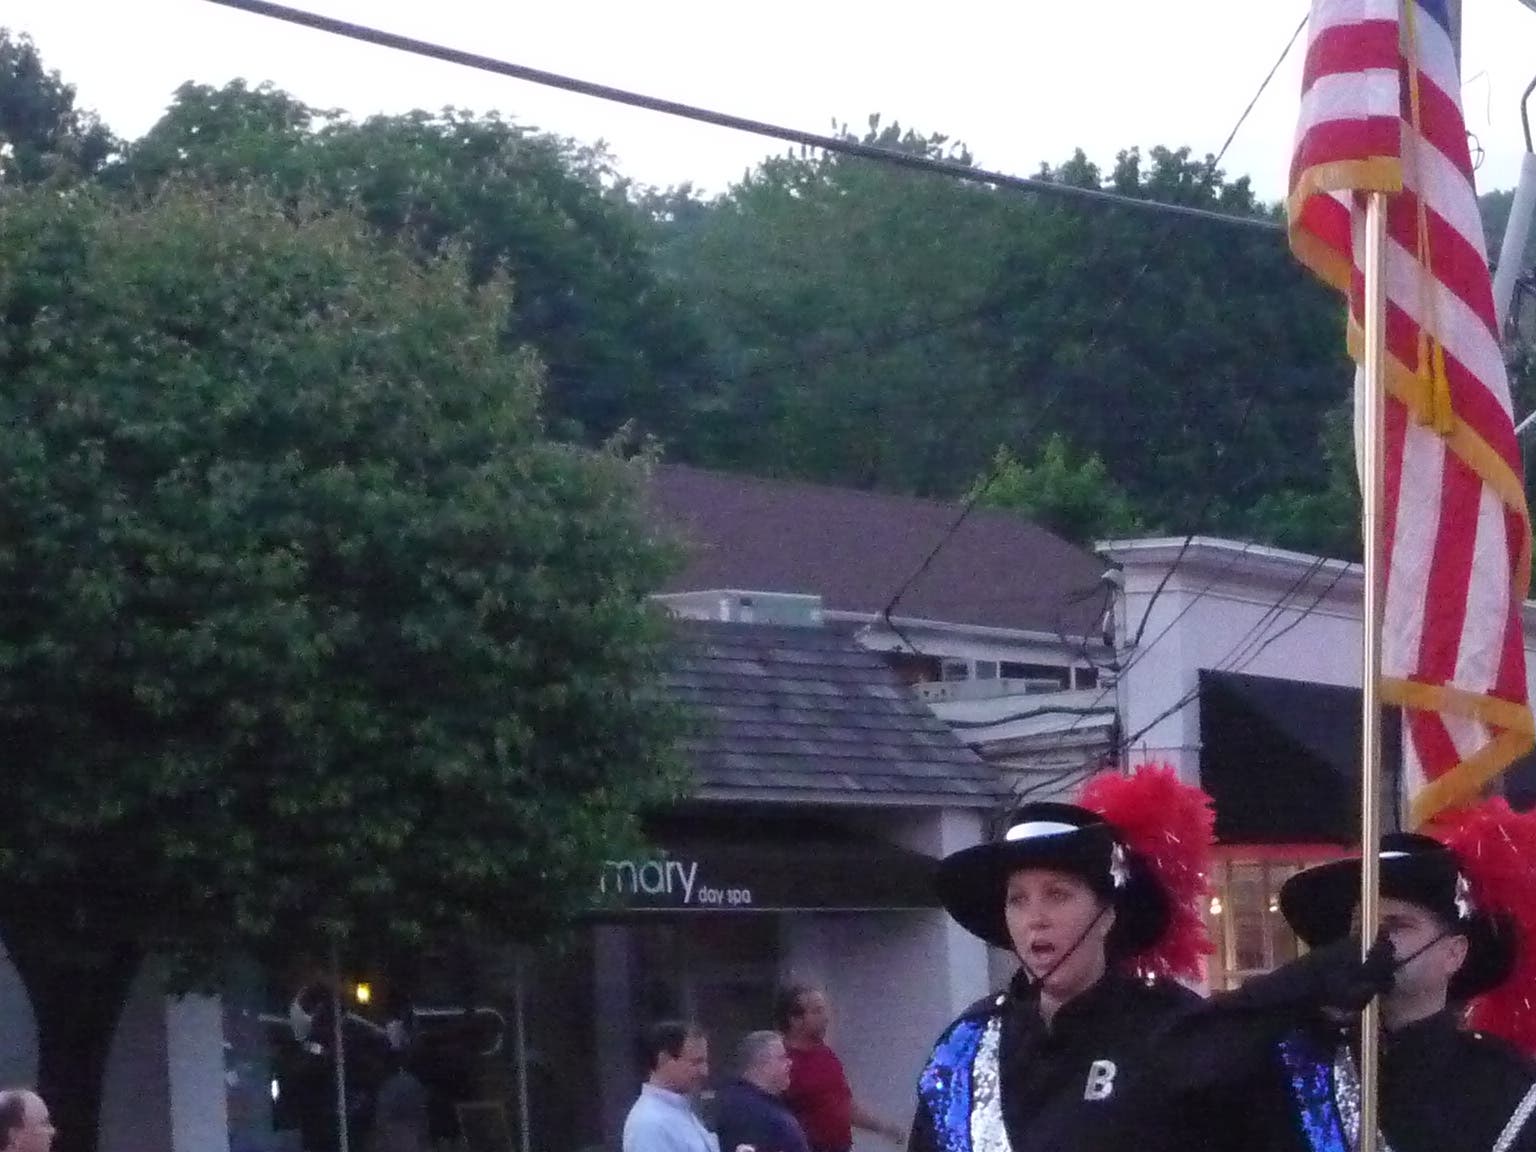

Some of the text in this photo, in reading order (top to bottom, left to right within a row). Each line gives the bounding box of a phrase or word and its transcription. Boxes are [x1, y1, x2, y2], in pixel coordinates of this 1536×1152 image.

[698, 886, 724, 904] day
[727, 887, 752, 905] spa
[1083, 1059, 1117, 1100] B
